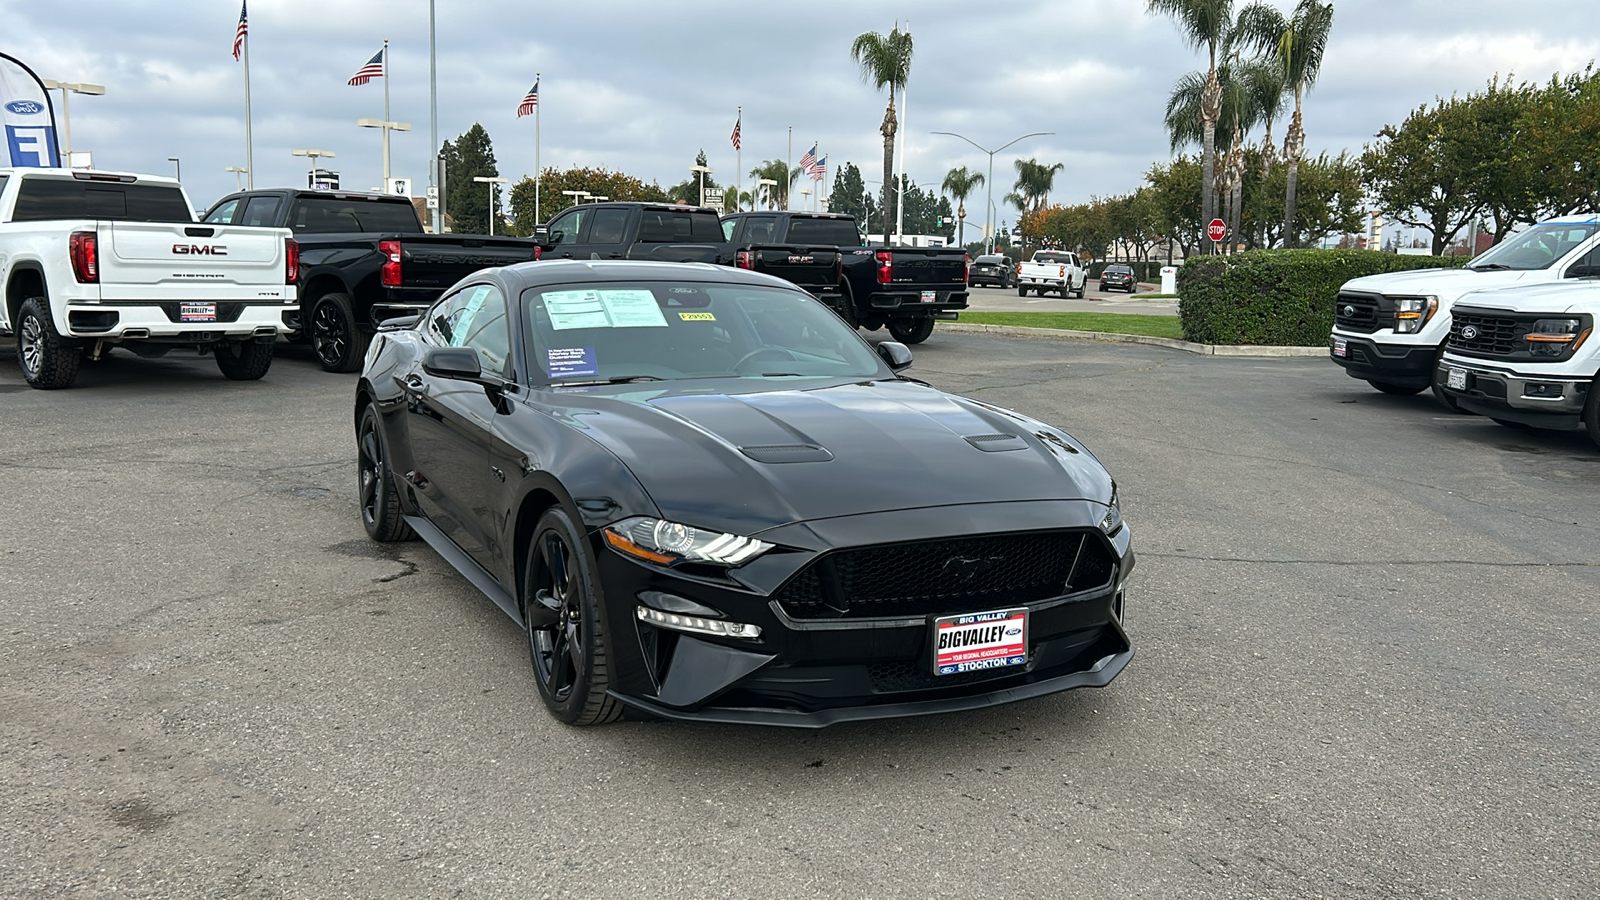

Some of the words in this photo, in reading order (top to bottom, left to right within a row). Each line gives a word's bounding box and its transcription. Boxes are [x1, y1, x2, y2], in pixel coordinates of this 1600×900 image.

[705, 189, 723, 197] OEM
[1209, 226, 1225, 234] STOP
[172, 244, 228, 256] GMC
[181, 306, 208, 314] BIGVALLEY
[959, 616, 975, 624] BIG
[977, 612, 1008, 622] VALLEY
[939, 625, 1006, 649] BIGVALLEY
[963, 652, 980, 660] REGIONAL
[981, 649, 1008, 658] HEADQUARTERS
[958, 658, 1007, 672] STOCKTON
